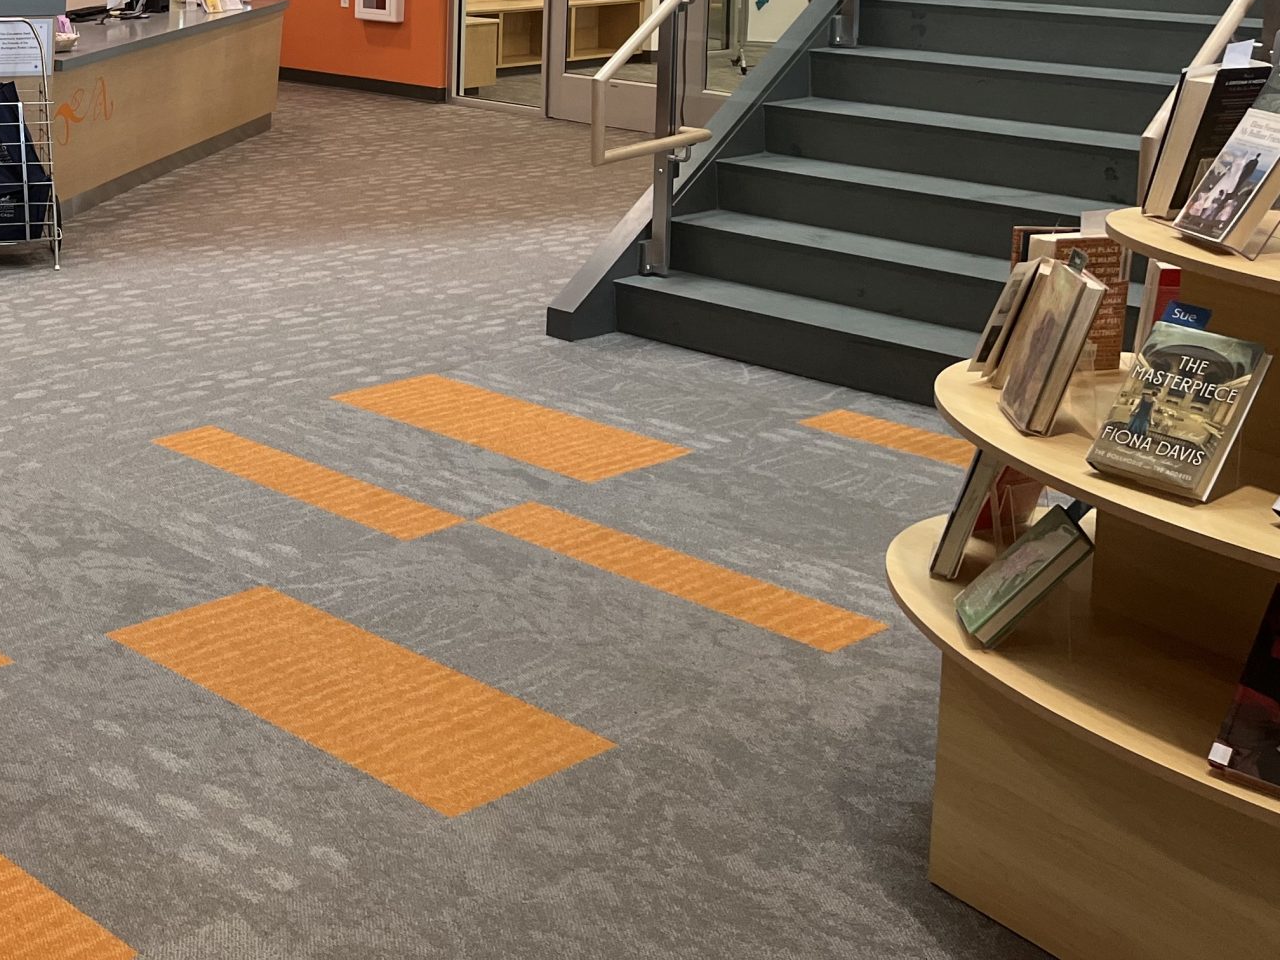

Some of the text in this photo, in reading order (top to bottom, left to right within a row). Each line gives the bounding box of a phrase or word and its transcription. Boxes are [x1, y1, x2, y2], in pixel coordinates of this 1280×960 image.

[1172, 308, 1199, 323] Sue
[1179, 355, 1210, 376] THE
[1131, 365, 1238, 404] MASTERPIECE
[1101, 425, 1205, 466] FIONA DAVIS
